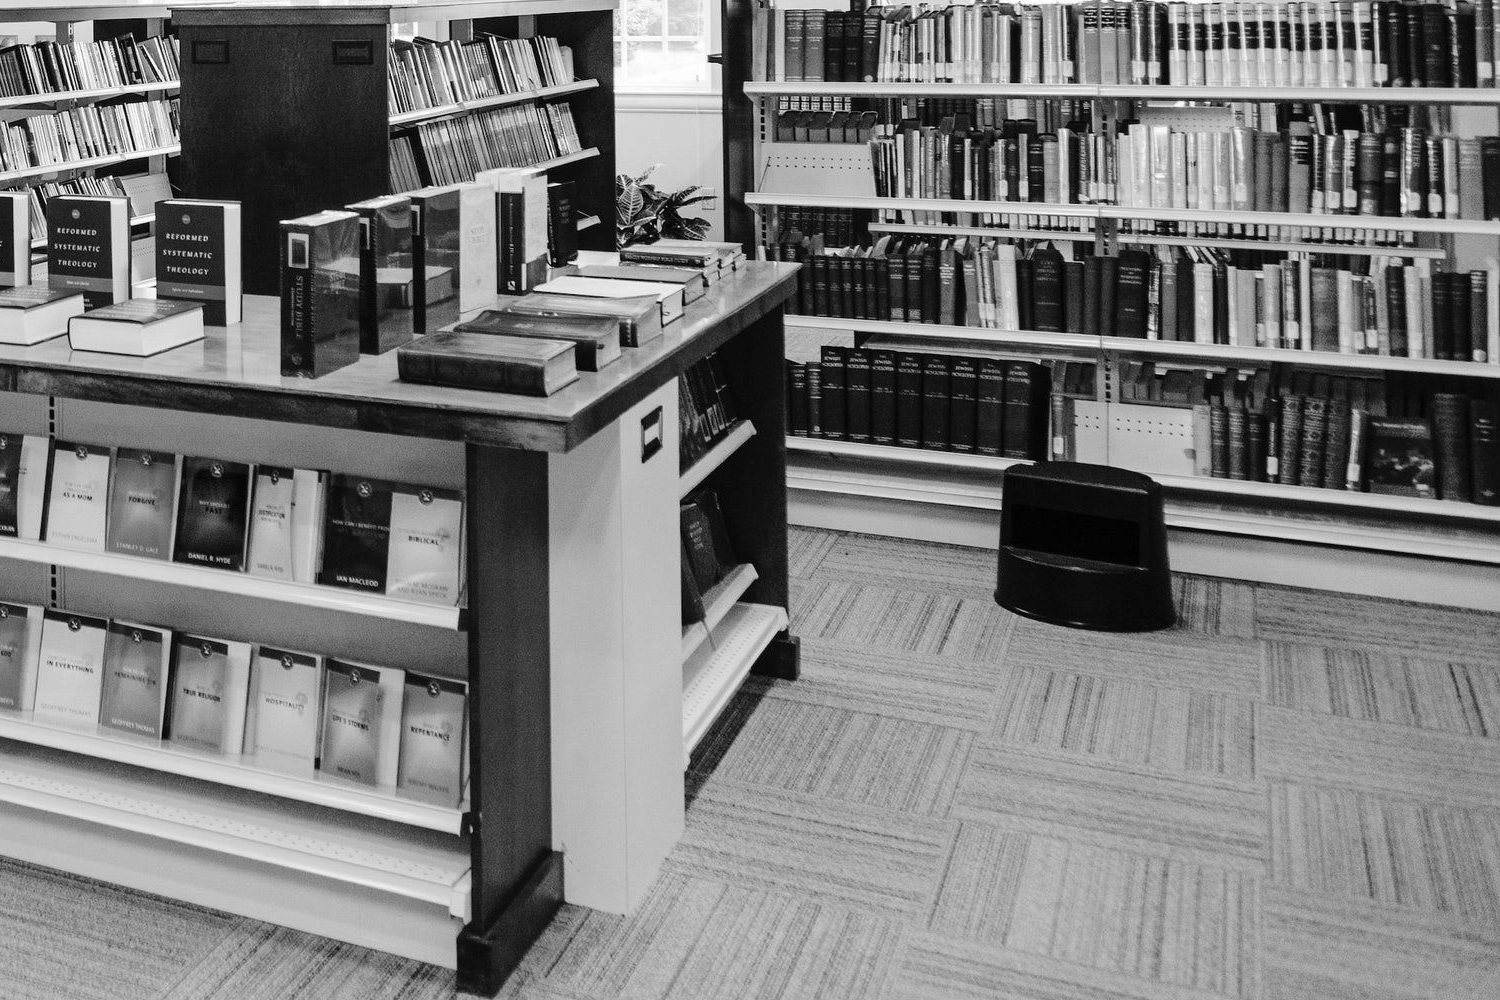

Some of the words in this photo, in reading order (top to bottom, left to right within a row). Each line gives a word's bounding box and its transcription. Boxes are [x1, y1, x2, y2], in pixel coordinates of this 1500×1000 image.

[56, 227, 97, 236] REFORMED
[166, 233, 209, 242] REFORMED
[54, 243, 100, 253] SYSTEMATIC
[163, 250, 213, 259] SYSTEMATIC
[57, 259, 98, 269] THEOLOGY
[166, 266, 209, 276] THEOLOGY
[296, 275, 304, 309] STUDY
[296, 311, 304, 339] BIBLE
[128, 496, 155, 506] FORGIVE
[205, 506, 222, 514] FAST
[408, 535, 439, 546] BIBLICAL
[116, 542, 138, 551] STANLEY
[146, 545, 159, 554] GALE
[188, 553, 208, 561] DANIEL
[215, 556, 231, 565] HYDE
[336, 575, 348, 583] IAN
[349, 577, 379, 587] MACLEOD
[427, 590, 448, 599] SPECK
[0, 650, 12, 658] GOD
[55, 661, 94, 674] EVERYTHING
[114, 672, 146, 684] REMAINING
[183, 687, 197, 697] TRUE
[198, 692, 221, 703] RELIGION
[265, 697, 304, 711] HOSPITALITY
[40, 703, 67, 713] GEOFFREY
[68, 708, 92, 718] THOMAS
[111, 718, 134, 729] GEOFFREY
[135, 722, 155, 734] THOMAS
[332, 714, 347, 725] LIFE'S
[348, 719, 369, 731] STORMS
[410, 726, 450, 741] REPENTANCE
